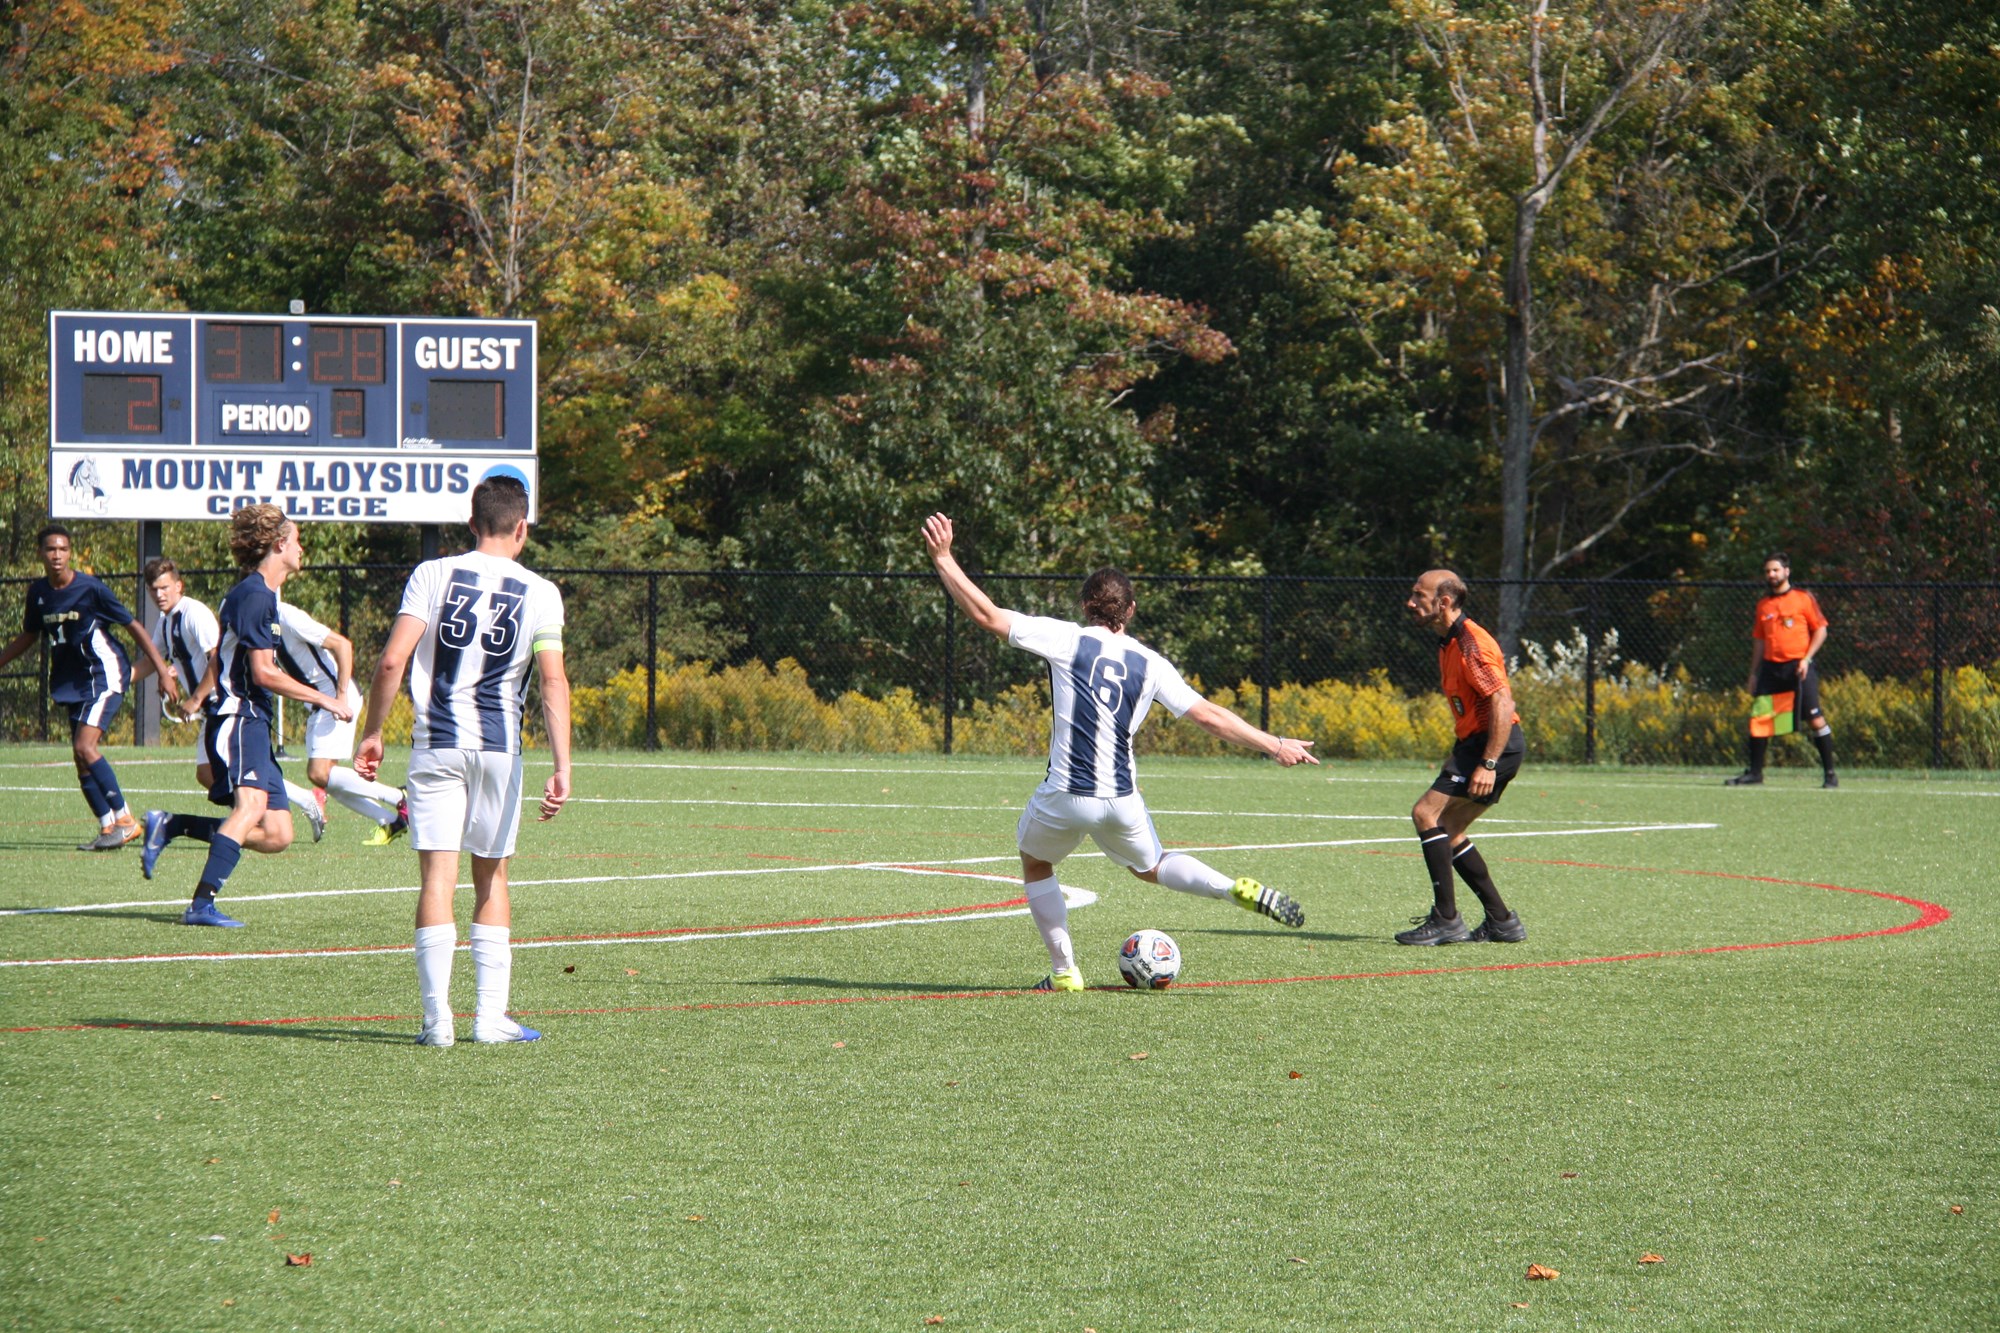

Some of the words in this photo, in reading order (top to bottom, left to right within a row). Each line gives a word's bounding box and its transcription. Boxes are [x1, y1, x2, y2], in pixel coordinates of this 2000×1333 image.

[74, 329, 173, 364] HOME
[414, 336, 521, 370] GUEST
[128, 376, 158, 431] 2
[221, 403, 311, 432] PERIOD
[336, 391, 362, 436] 2
[121, 458, 262, 490] MOUNT
[276, 461, 469, 494] ALOYSIUS
[440, 582, 524, 656] 33
[1089, 655, 1127, 715] 6
